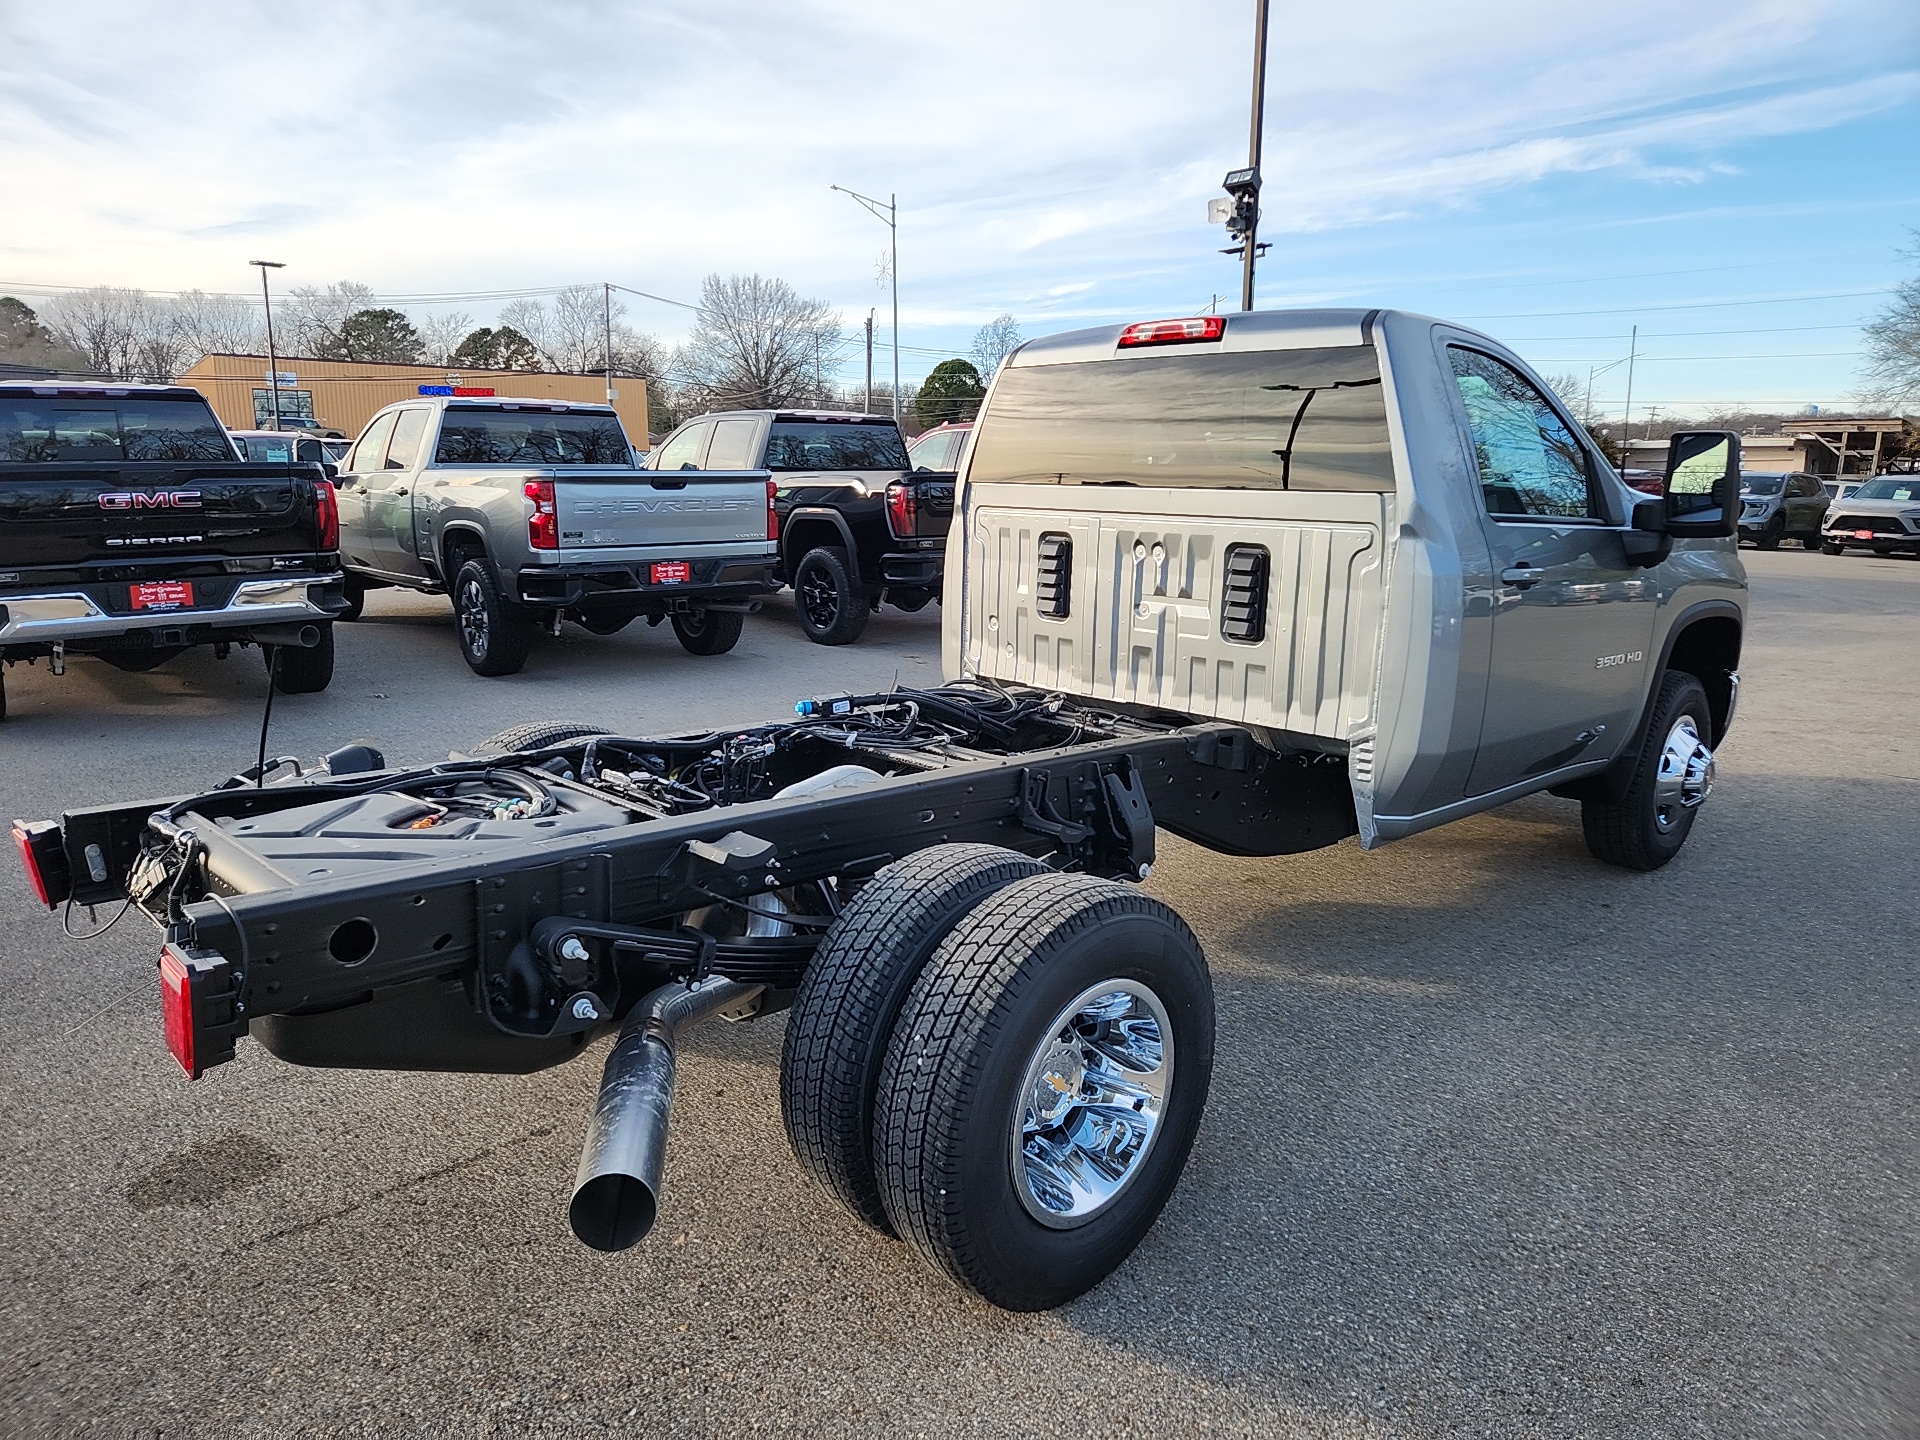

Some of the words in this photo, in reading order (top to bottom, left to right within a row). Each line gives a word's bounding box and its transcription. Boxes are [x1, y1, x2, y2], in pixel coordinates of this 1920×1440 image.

[418, 385, 454, 396] SUPER
[98, 491, 202, 510] GMC
[573, 498, 757, 514] CHEVROLET
[106, 536, 203, 546] SIERRA
[1594, 653, 1626, 669] 3500
[1626, 650, 1643, 663] HD
